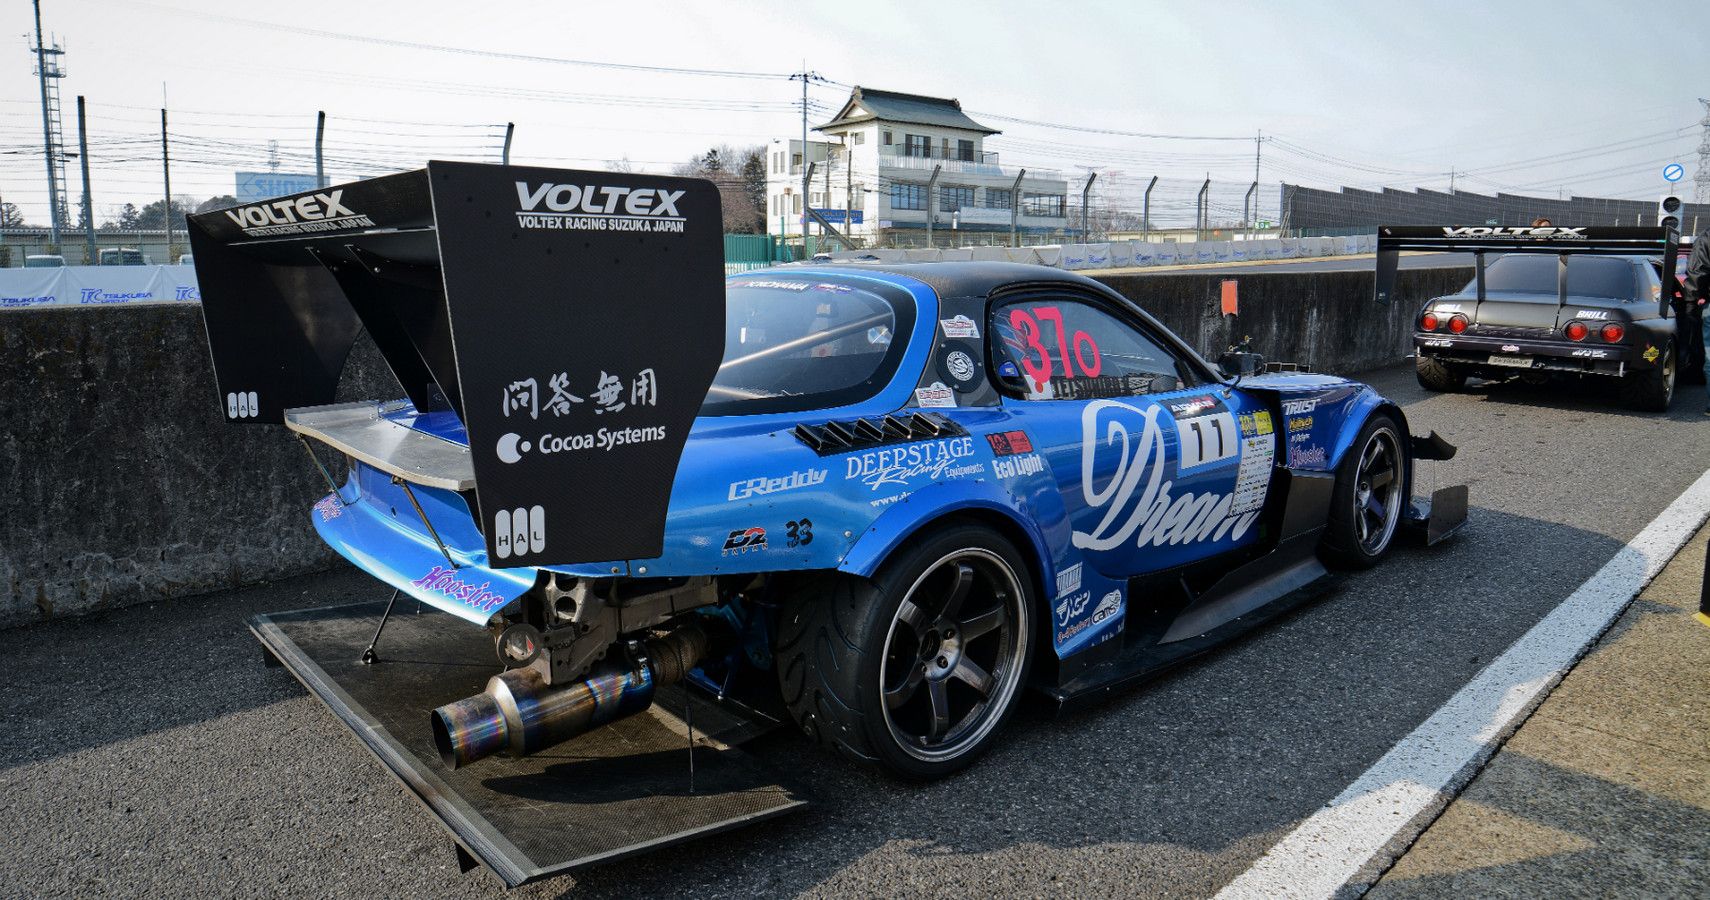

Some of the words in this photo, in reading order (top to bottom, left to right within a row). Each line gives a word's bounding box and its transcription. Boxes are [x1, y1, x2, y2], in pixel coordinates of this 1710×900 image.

[225, 189, 355, 229] VOLTEX
[515, 181, 687, 216] VOLTEX
[301, 220, 340, 233] SUZUKA
[338, 216, 376, 229] JAPAN
[518, 216, 564, 229] VOLTEX
[565, 217, 607, 231] RACING
[608, 219, 651, 232] SUZUKA
[652, 221, 684, 233] JAPAN
[1442, 227, 1587, 237] VOLTEX
[1576, 310, 1609, 320] BRILL
[502, 368, 658, 421] 問答無用
[1281, 399, 1321, 416] TRUST
[539, 433, 595, 455] Cocoa
[596, 425, 667, 452] Systems
[1190, 418, 1225, 462] 11
[845, 437, 975, 480] DEEPSTAGE
[727, 468, 829, 501] GReddy
[862, 458, 956, 492] Racing
[1071, 399, 1263, 551] Dream
[723, 526, 767, 551] D2
[785, 518, 814, 549] 33
[721, 542, 769, 558] JAPAN
[409, 565, 505, 613] Hoosier
